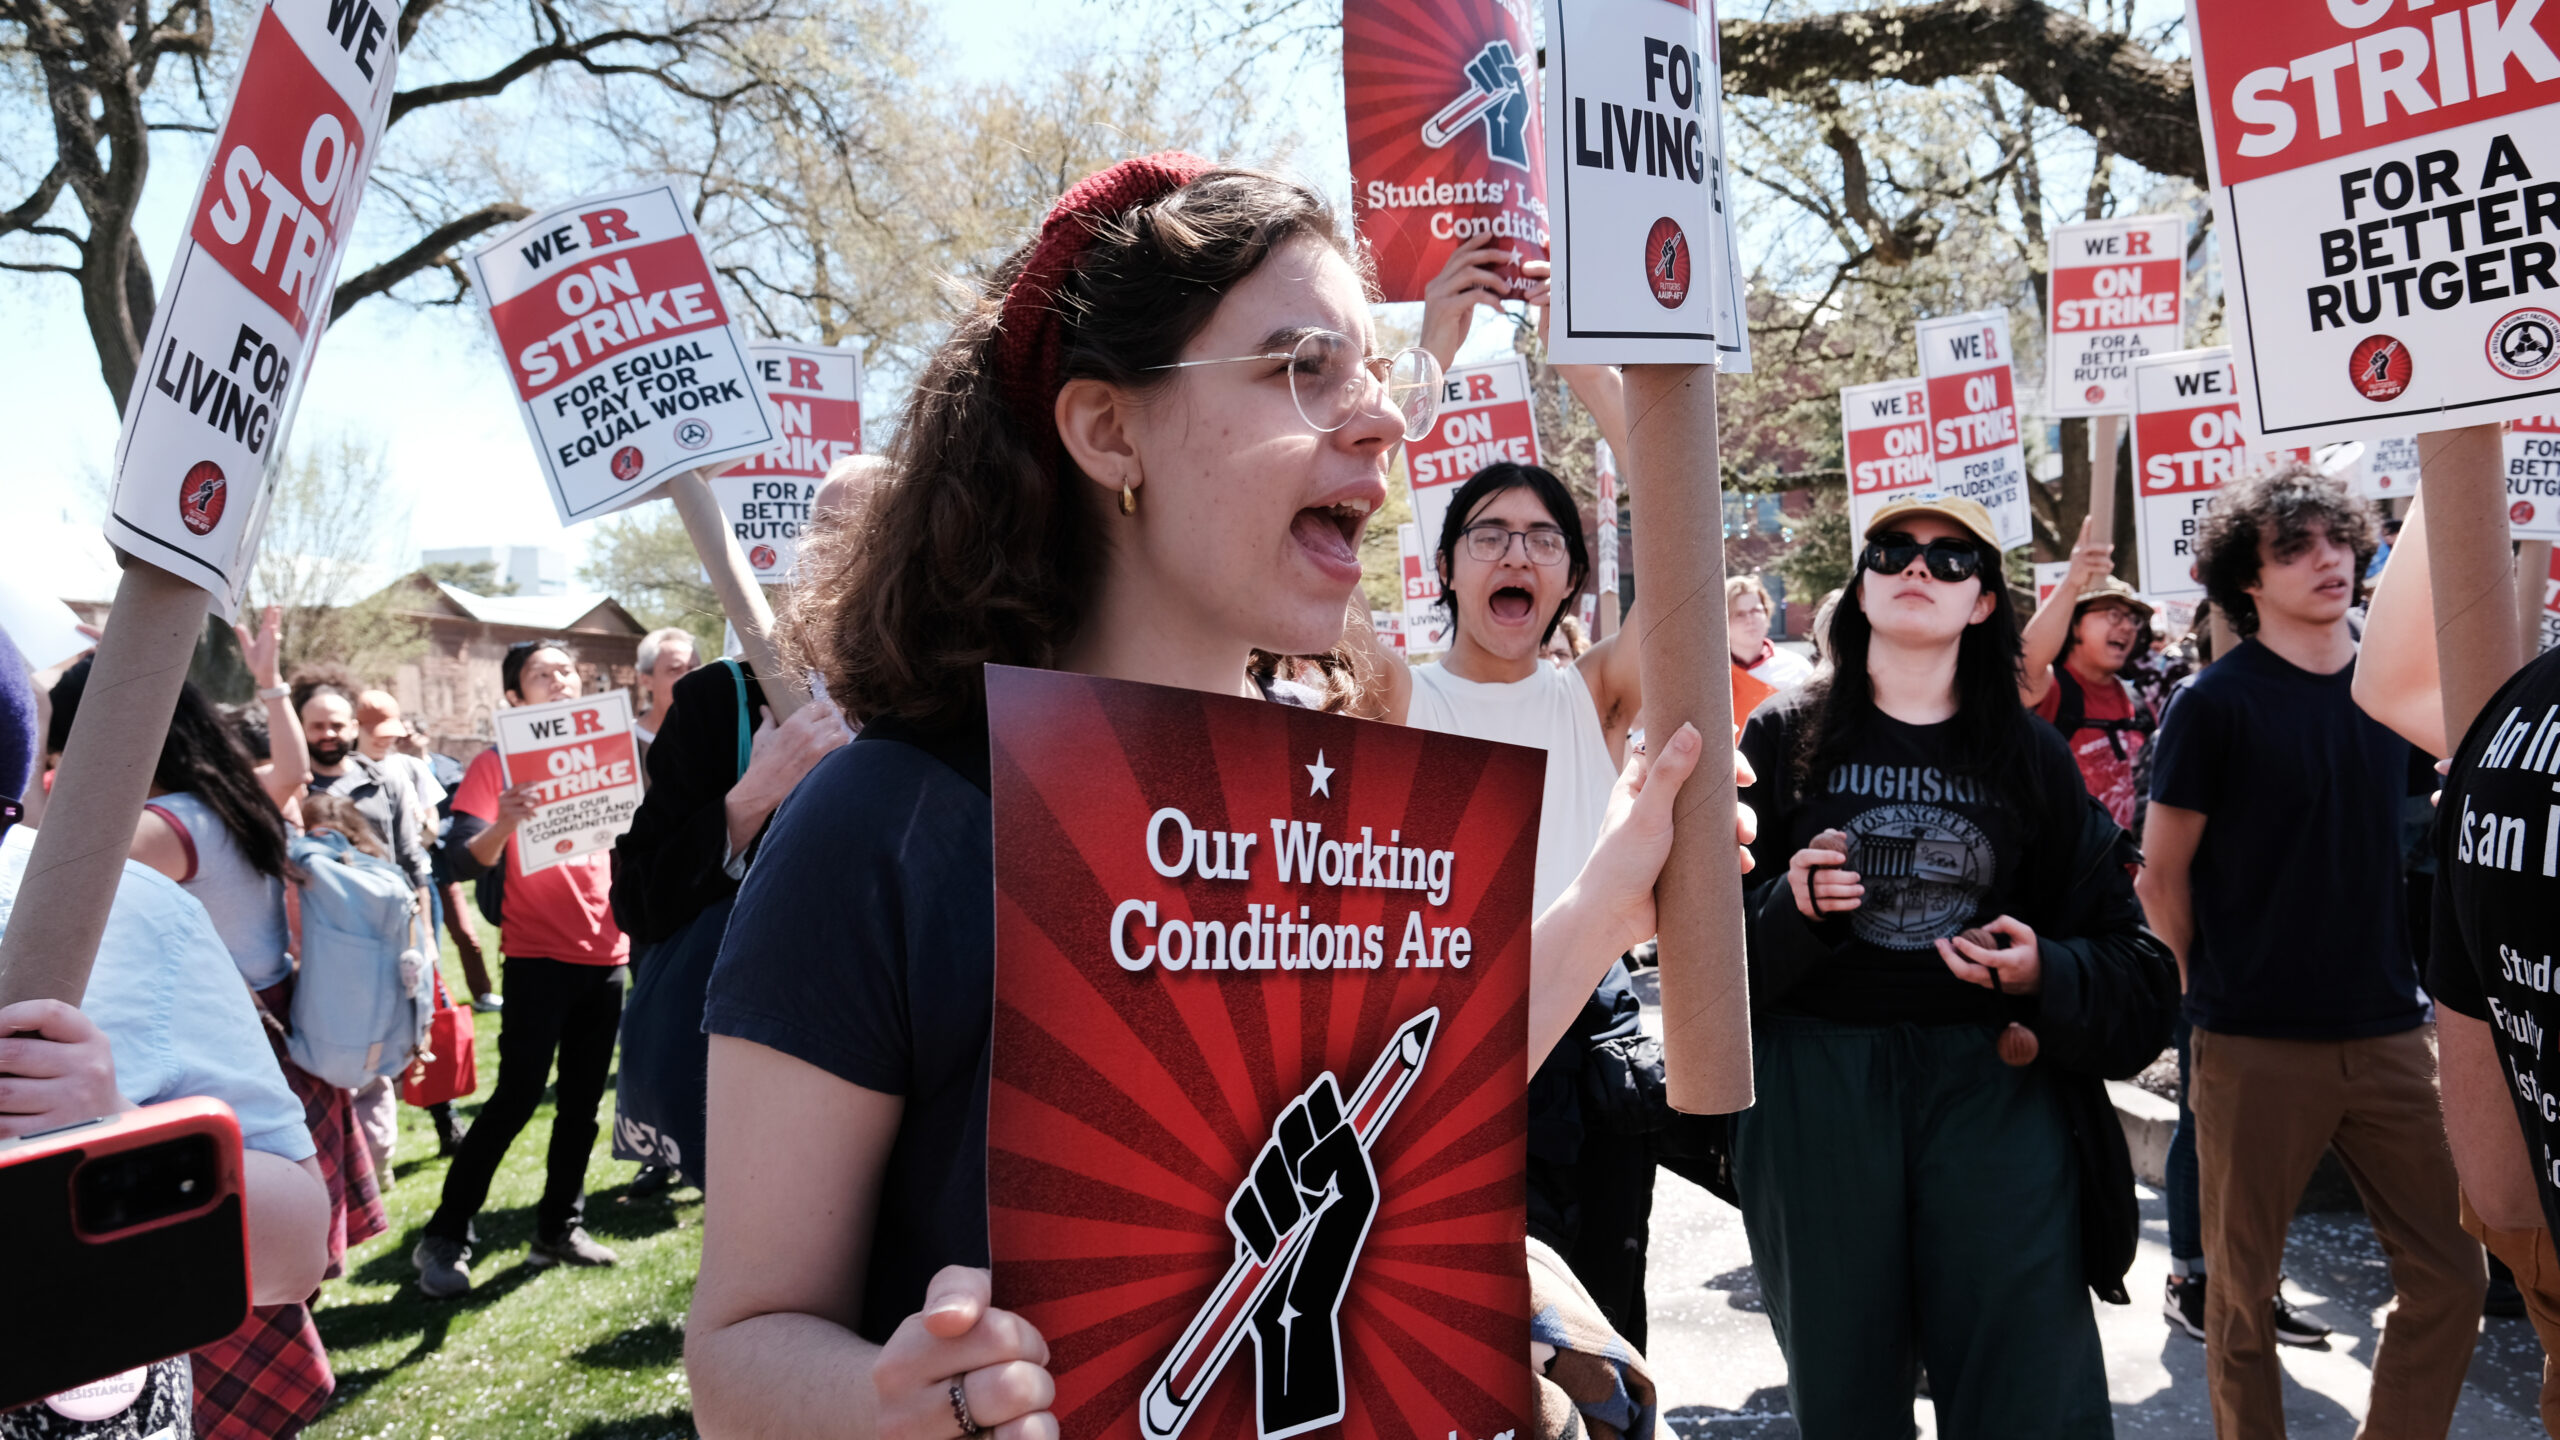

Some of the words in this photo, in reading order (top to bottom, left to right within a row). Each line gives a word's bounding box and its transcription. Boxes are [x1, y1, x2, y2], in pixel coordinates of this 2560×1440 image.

[326, 0, 387, 84] WE
[2231, 0, 2560, 158] STRIK
[1574, 97, 1704, 185] LIVING
[2340, 149, 2463, 220] FOR
[2480, 133, 2532, 190] A
[520, 225, 580, 269] WE
[579, 208, 640, 249] R
[1430, 210, 1549, 249] Conditio
[2085, 237, 2120, 256] WE
[2126, 231, 2152, 256] R
[2320, 181, 2560, 278] BETTER
[556, 258, 639, 317] ON
[1657, 290, 1684, 300] AAUP-AFT
[2092, 266, 2142, 298] ON
[2307, 241, 2560, 333] RUTGER
[2057, 292, 2176, 329] STRIKE
[519, 283, 716, 387] STRIKE
[1950, 335, 1981, 361] WE
[1983, 327, 1998, 360] R
[2091, 336, 2125, 350] FOR
[2131, 334, 2141, 346] A
[229, 323, 290, 410] FOR
[553, 375, 609, 417] FOR
[612, 341, 713, 386] EQUAL
[788, 357, 823, 391] R
[2074, 366, 2127, 382] RUTG
[2175, 371, 2221, 396] WE
[156, 336, 269, 454] LIVING
[581, 387, 629, 430] PAY
[637, 367, 699, 401] FOR
[1466, 374, 1497, 402] R
[1871, 397, 1902, 417] WE
[1906, 391, 1925, 416] R
[1964, 374, 1998, 413] ON
[558, 410, 650, 468] EQUAL
[650, 379, 744, 420] WORK
[1443, 411, 1493, 446] ON
[1883, 425, 1924, 457] ON
[1935, 406, 2016, 454] STRIKE
[2190, 410, 2246, 449] ON
[1414, 436, 1532, 483] STRIKE
[1856, 453, 1932, 490] STRIK
[1964, 462, 1989, 480] FOR
[2510, 458, 2560, 476] BETT
[753, 483, 797, 500] FOR
[743, 502, 811, 520] BETTE
[530, 717, 568, 740] WE
[571, 709, 604, 736] R
[2477, 706, 2532, 769] An
[547, 744, 596, 777] ON
[526, 808, 600, 836] STUDENTS
[605, 800, 635, 814] AND
[547, 804, 575, 818] FOR
[580, 795, 609, 809] OUR
[531, 811, 631, 844] COMMUNITIES
[1849, 811, 1888, 840] LOS
[1892, 806, 1983, 850] ANGELES
[2458, 794, 2476, 864] Is
[2477, 813, 2527, 872] an
[1146, 807, 1257, 881] Our
[1270, 818, 1455, 906] Working
[1110, 898, 1384, 972] Conditions
[1395, 911, 1472, 969] Are
[57, 1382, 136, 1402] RESISTANCE
